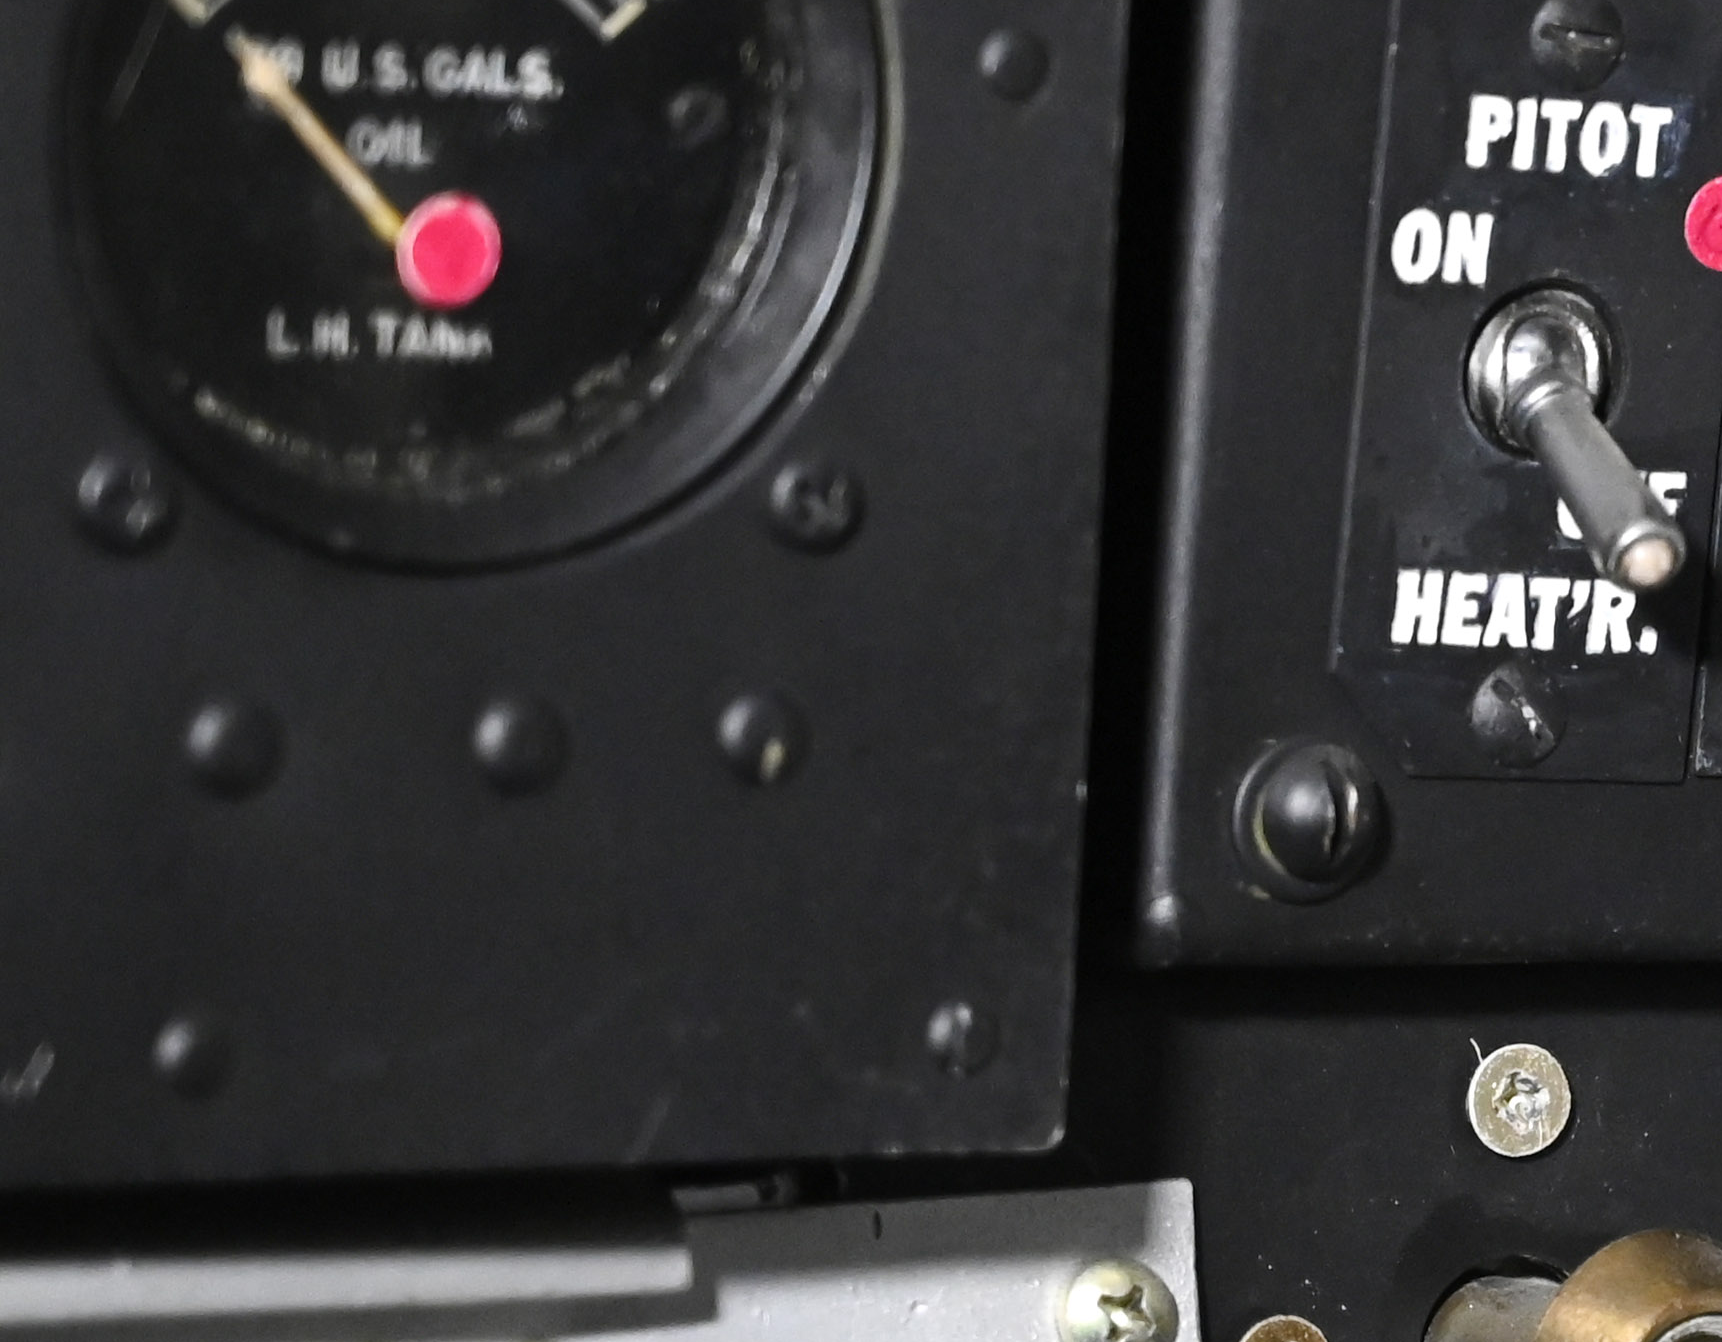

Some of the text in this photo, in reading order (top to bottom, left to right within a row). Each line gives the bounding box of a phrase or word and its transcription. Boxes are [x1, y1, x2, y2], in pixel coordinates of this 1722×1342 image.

[343, 117, 434, 167] OIL
[1466, 95, 1674, 178] PITOT
[1391, 208, 1494, 286] ON
[1391, 569, 1660, 655] HEAT'R.
